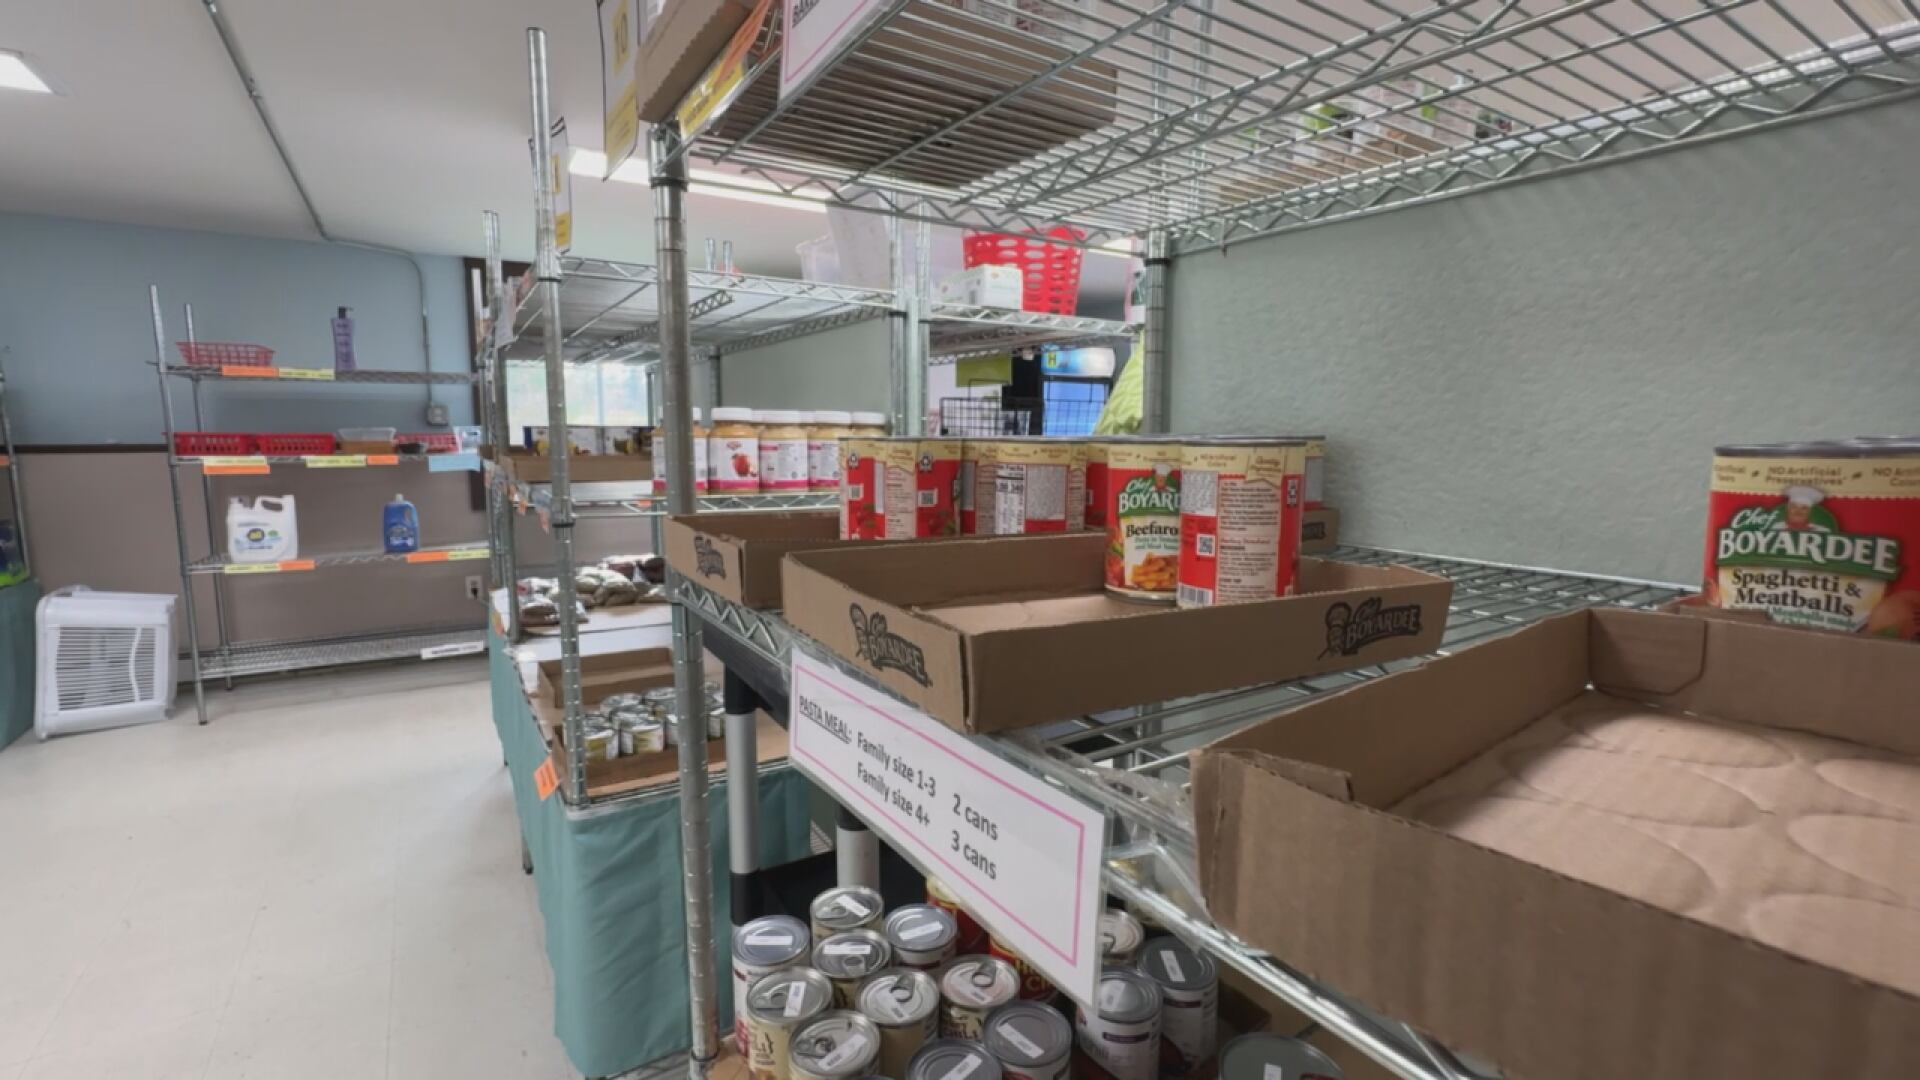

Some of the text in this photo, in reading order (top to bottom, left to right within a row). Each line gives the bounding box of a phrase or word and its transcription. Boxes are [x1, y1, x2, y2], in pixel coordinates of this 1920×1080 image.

[1788, 466, 1842, 476] Artificial
[1126, 477, 1153, 495] Chef
[1118, 492, 1181, 513] BOYAR
[1126, 520, 1179, 538] Beefaro
[1731, 508, 1781, 530] Chef
[1718, 530, 1897, 574] BOYARDEE
[1732, 567, 1863, 599] Spaghetti &
[1734, 587, 1855, 617] Meatballs
[799, 695, 998, 841] PASTA MEAL: Family size 1-3 2 cans
[857, 760, 997, 880] Family size 4+ 3 cans
